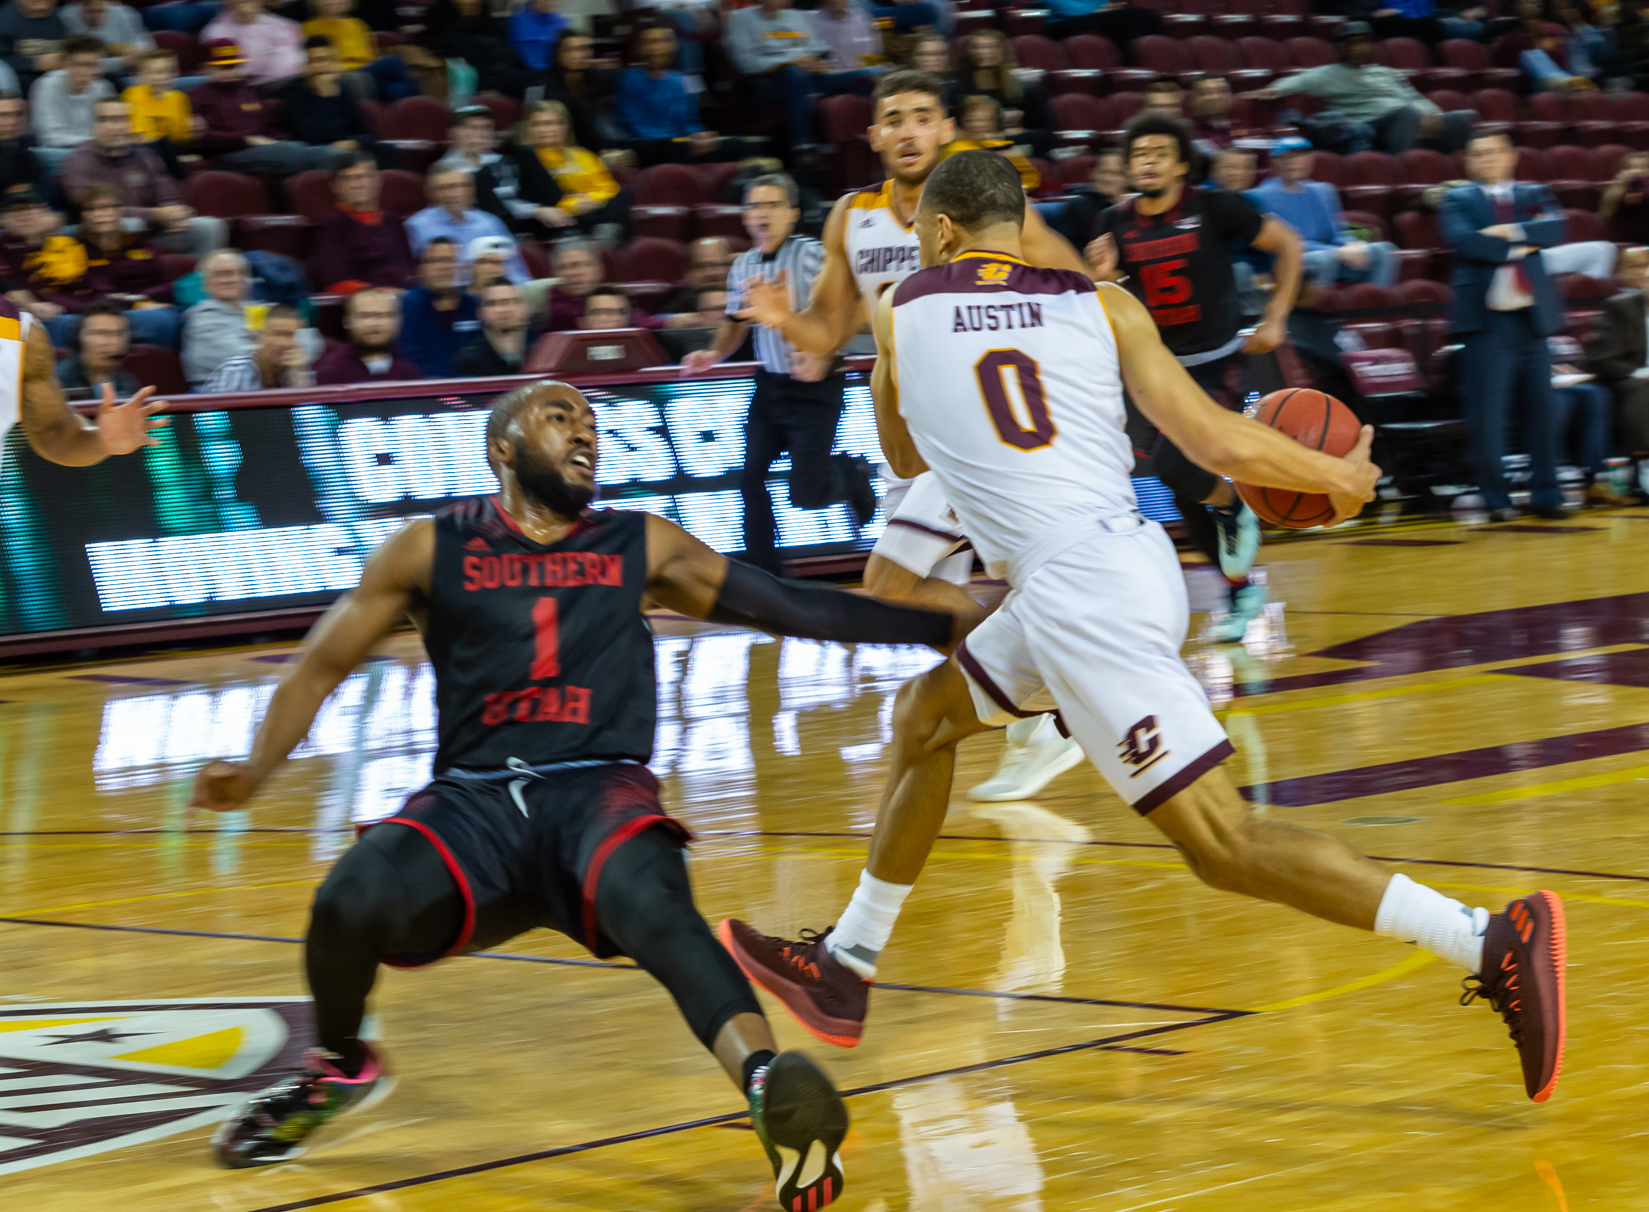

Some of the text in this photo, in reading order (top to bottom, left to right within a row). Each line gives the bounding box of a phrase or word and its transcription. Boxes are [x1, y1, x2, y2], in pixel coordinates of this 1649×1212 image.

[953, 302, 1044, 332] AUSTIN
[973, 347, 1058, 453] 0
[463, 552, 624, 591] SOUTHERN
[529, 597, 561, 680] 1
[481, 685, 593, 726] UTAH
